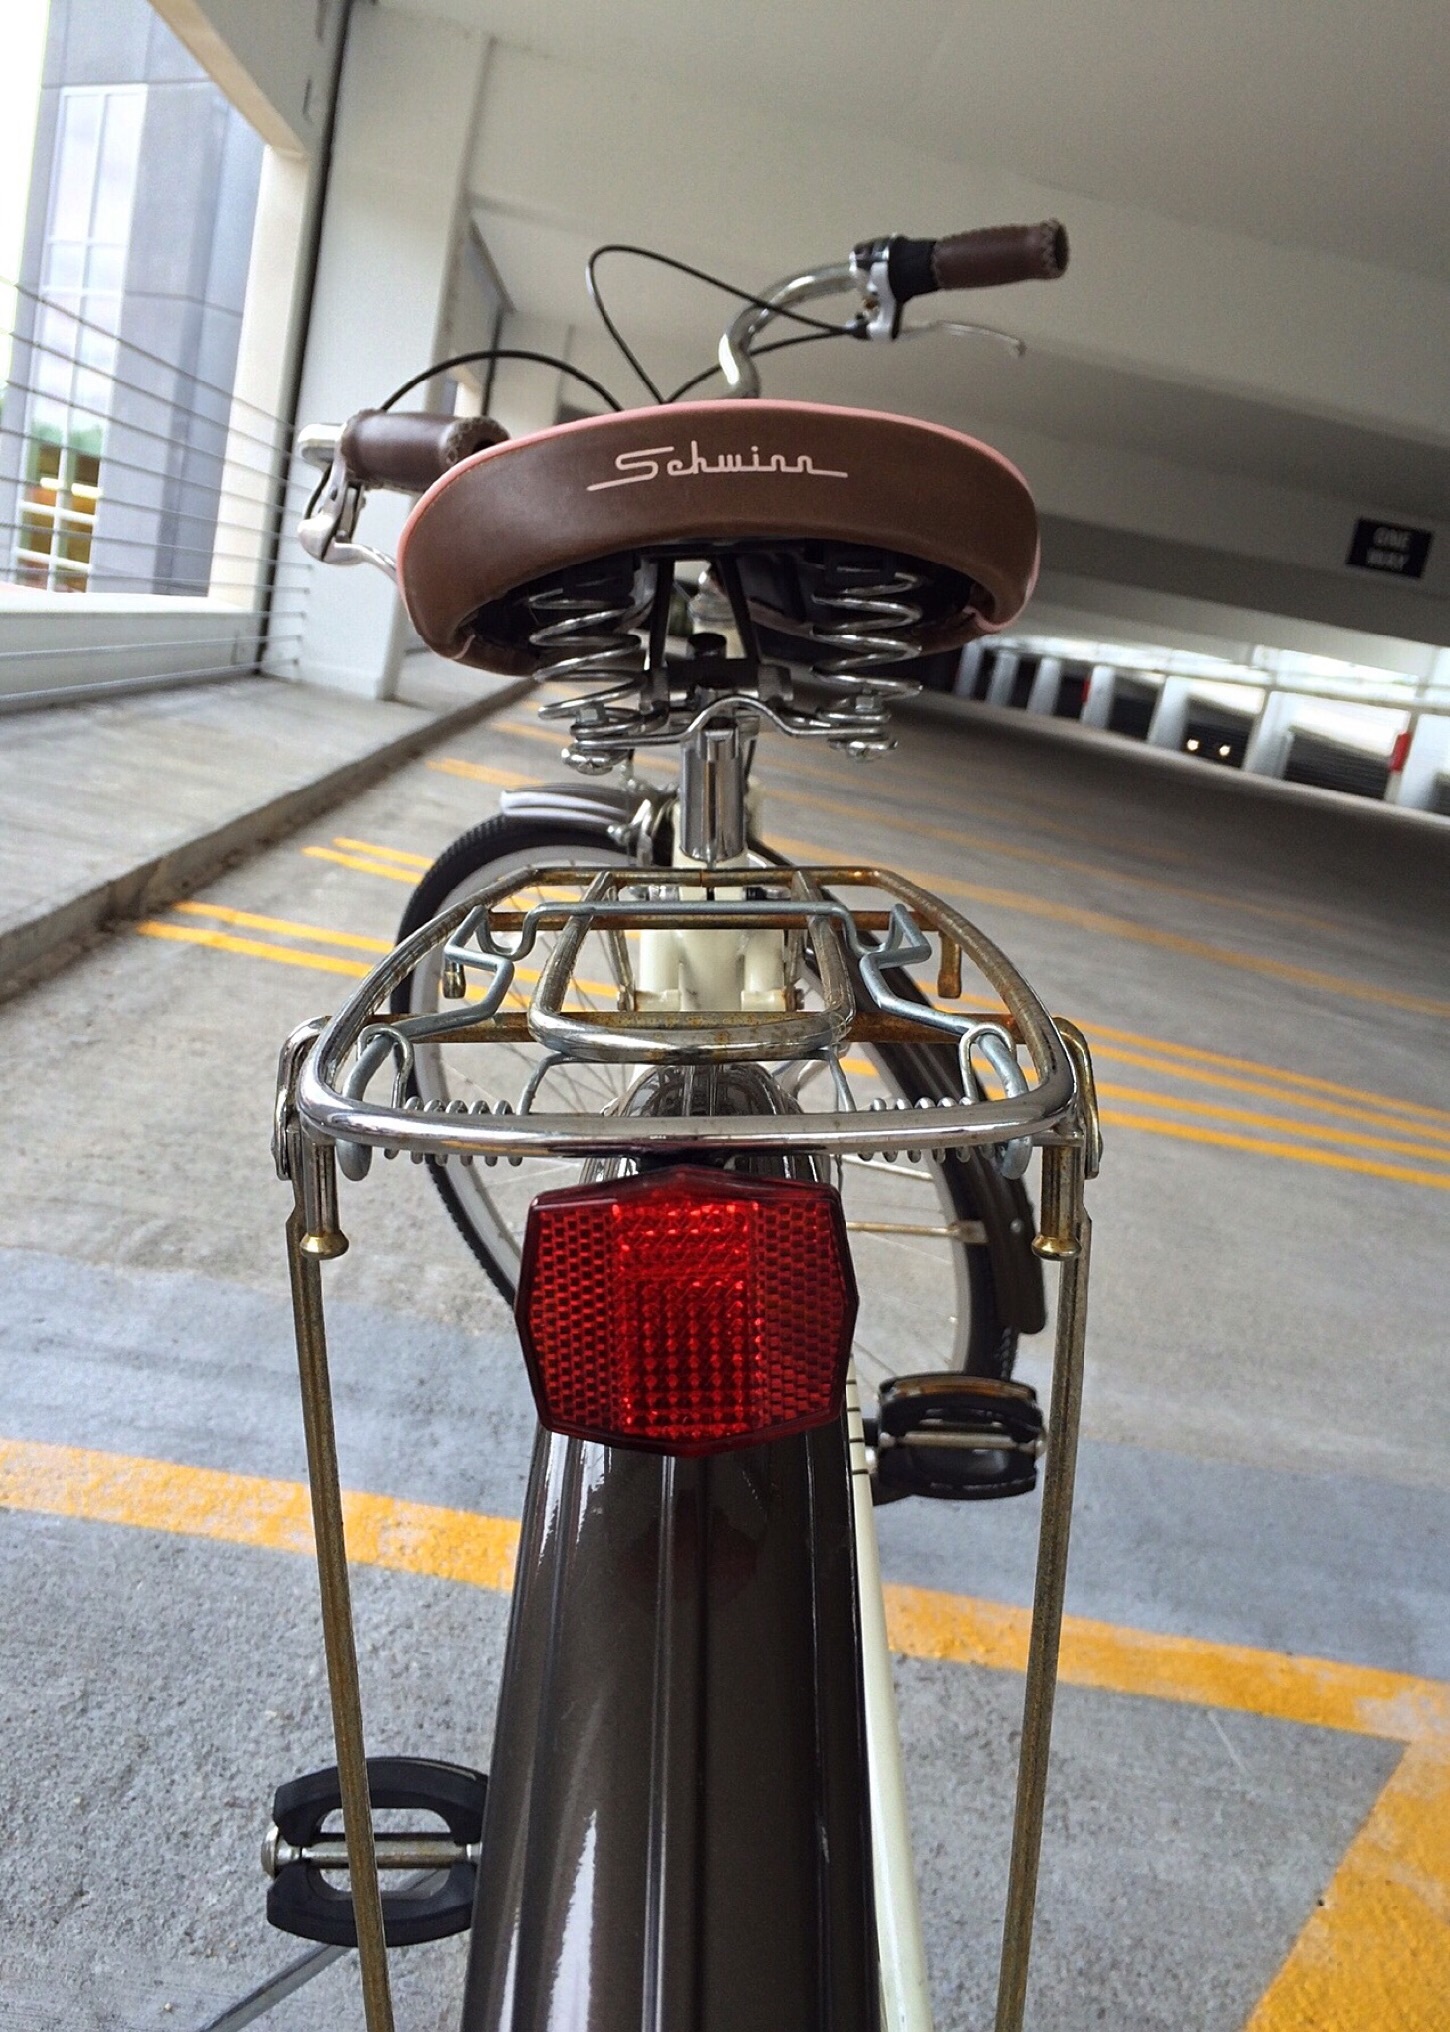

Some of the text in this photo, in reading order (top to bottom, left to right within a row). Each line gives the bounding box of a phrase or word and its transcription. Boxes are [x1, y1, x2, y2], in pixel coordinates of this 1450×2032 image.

[586, 440, 848, 491] Schwinn
[1373, 526, 1412, 549] ONE
[1366, 548, 1409, 571] WAY
